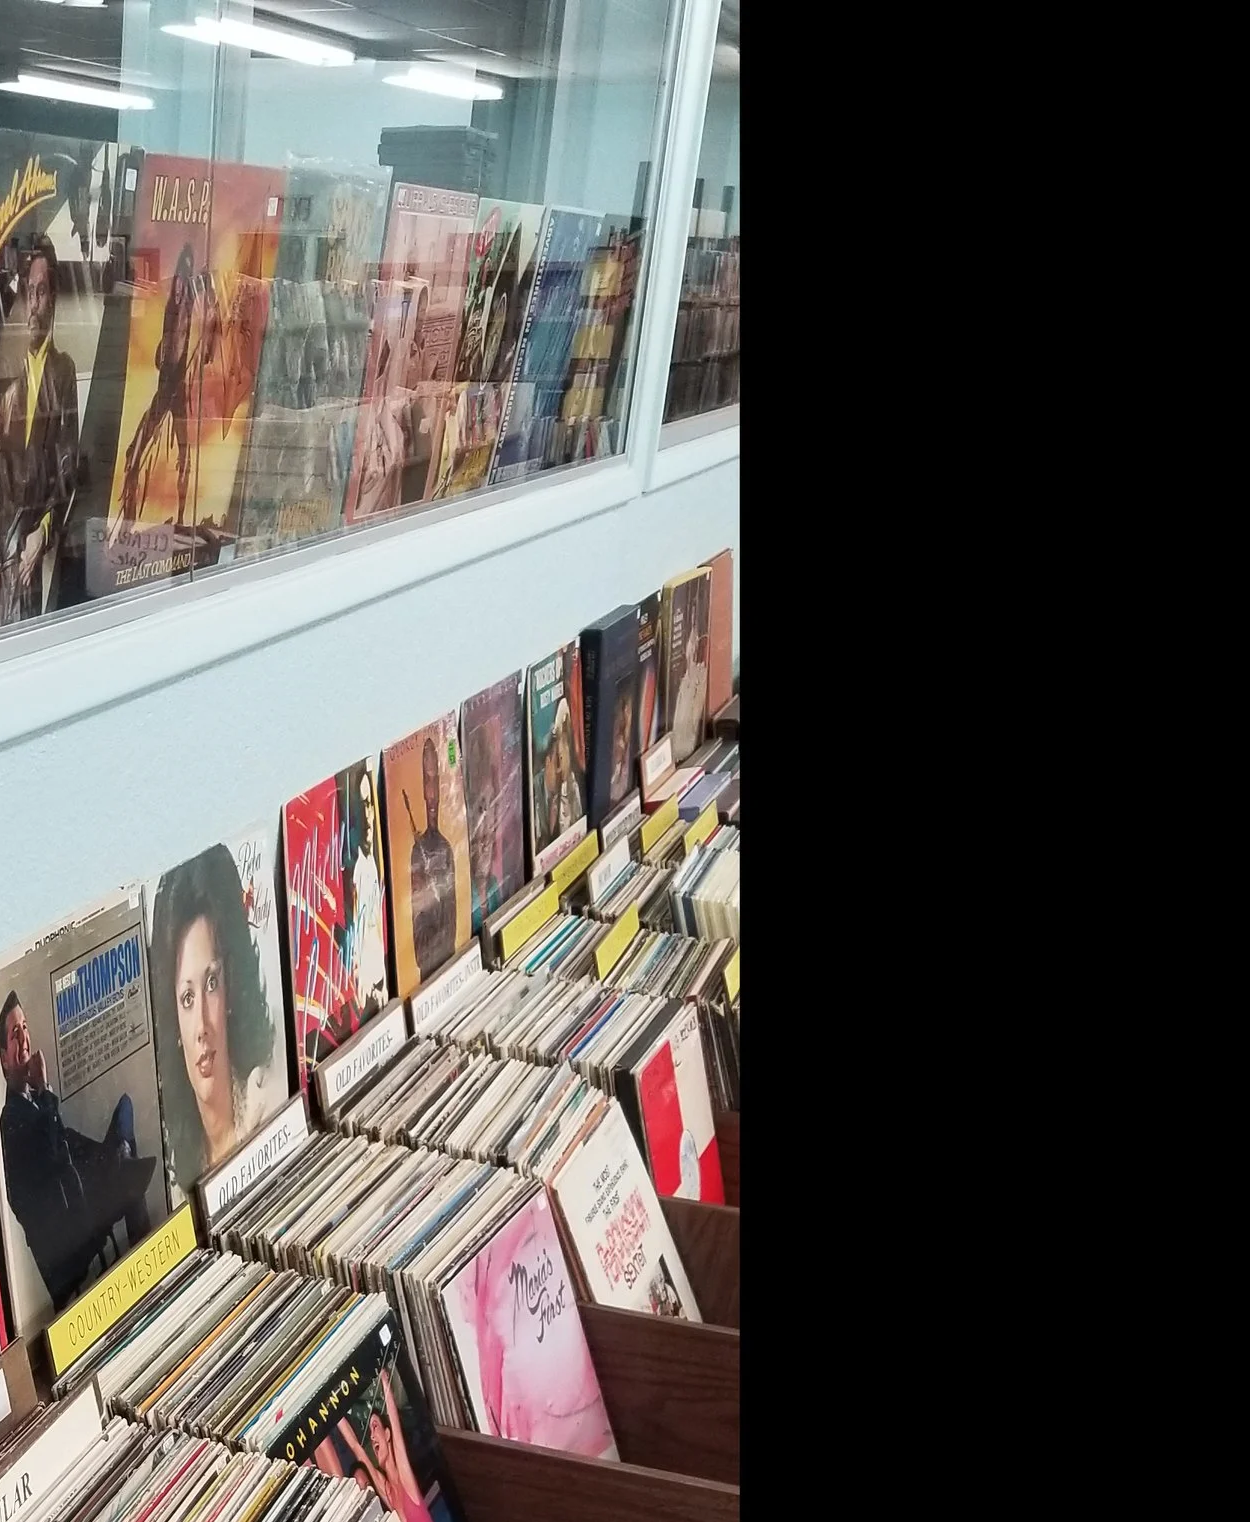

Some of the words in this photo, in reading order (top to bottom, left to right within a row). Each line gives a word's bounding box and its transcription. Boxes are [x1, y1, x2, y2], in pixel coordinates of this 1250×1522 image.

[56, 986, 81, 1022] HANK
[77, 934, 141, 1010] THOMPSON
[336, 1065, 352, 1093] OLD
[218, 1174, 239, 1209] OLD
[67, 1228, 181, 1347] COUNTRY-WESTERN
[536, 1279, 567, 1344] First
[285, 1364, 362, 1462] OHANNON
